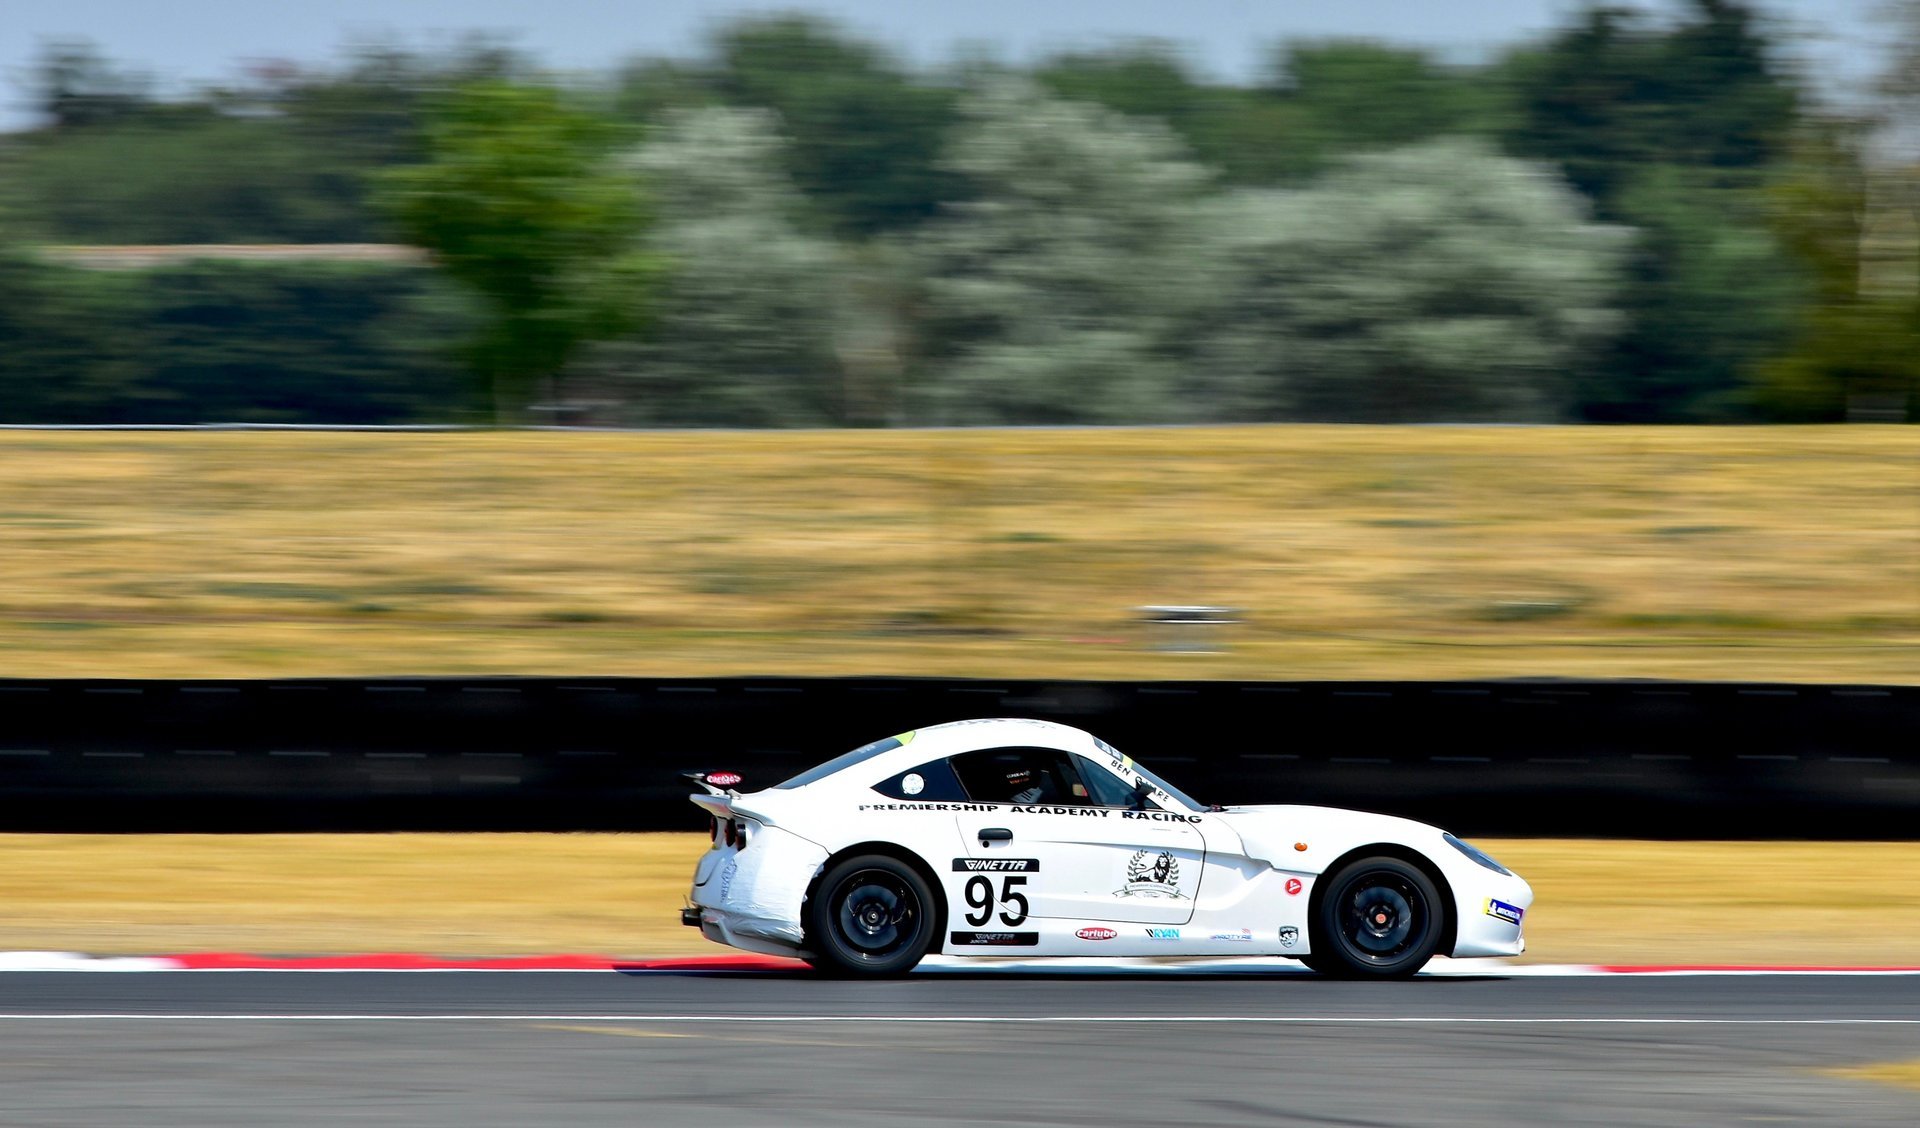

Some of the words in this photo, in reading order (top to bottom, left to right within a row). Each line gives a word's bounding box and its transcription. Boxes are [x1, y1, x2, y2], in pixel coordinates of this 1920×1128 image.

[1111, 760, 1131, 776] BEN
[858, 803, 999, 812] PREMIERSHIP
[1010, 806, 1110, 818] ACADEMY
[1122, 811, 1202, 823] RACING
[964, 860, 1028, 870] GINETTA
[964, 875, 1029, 927] 95
[1076, 928, 1116, 938] Carlube
